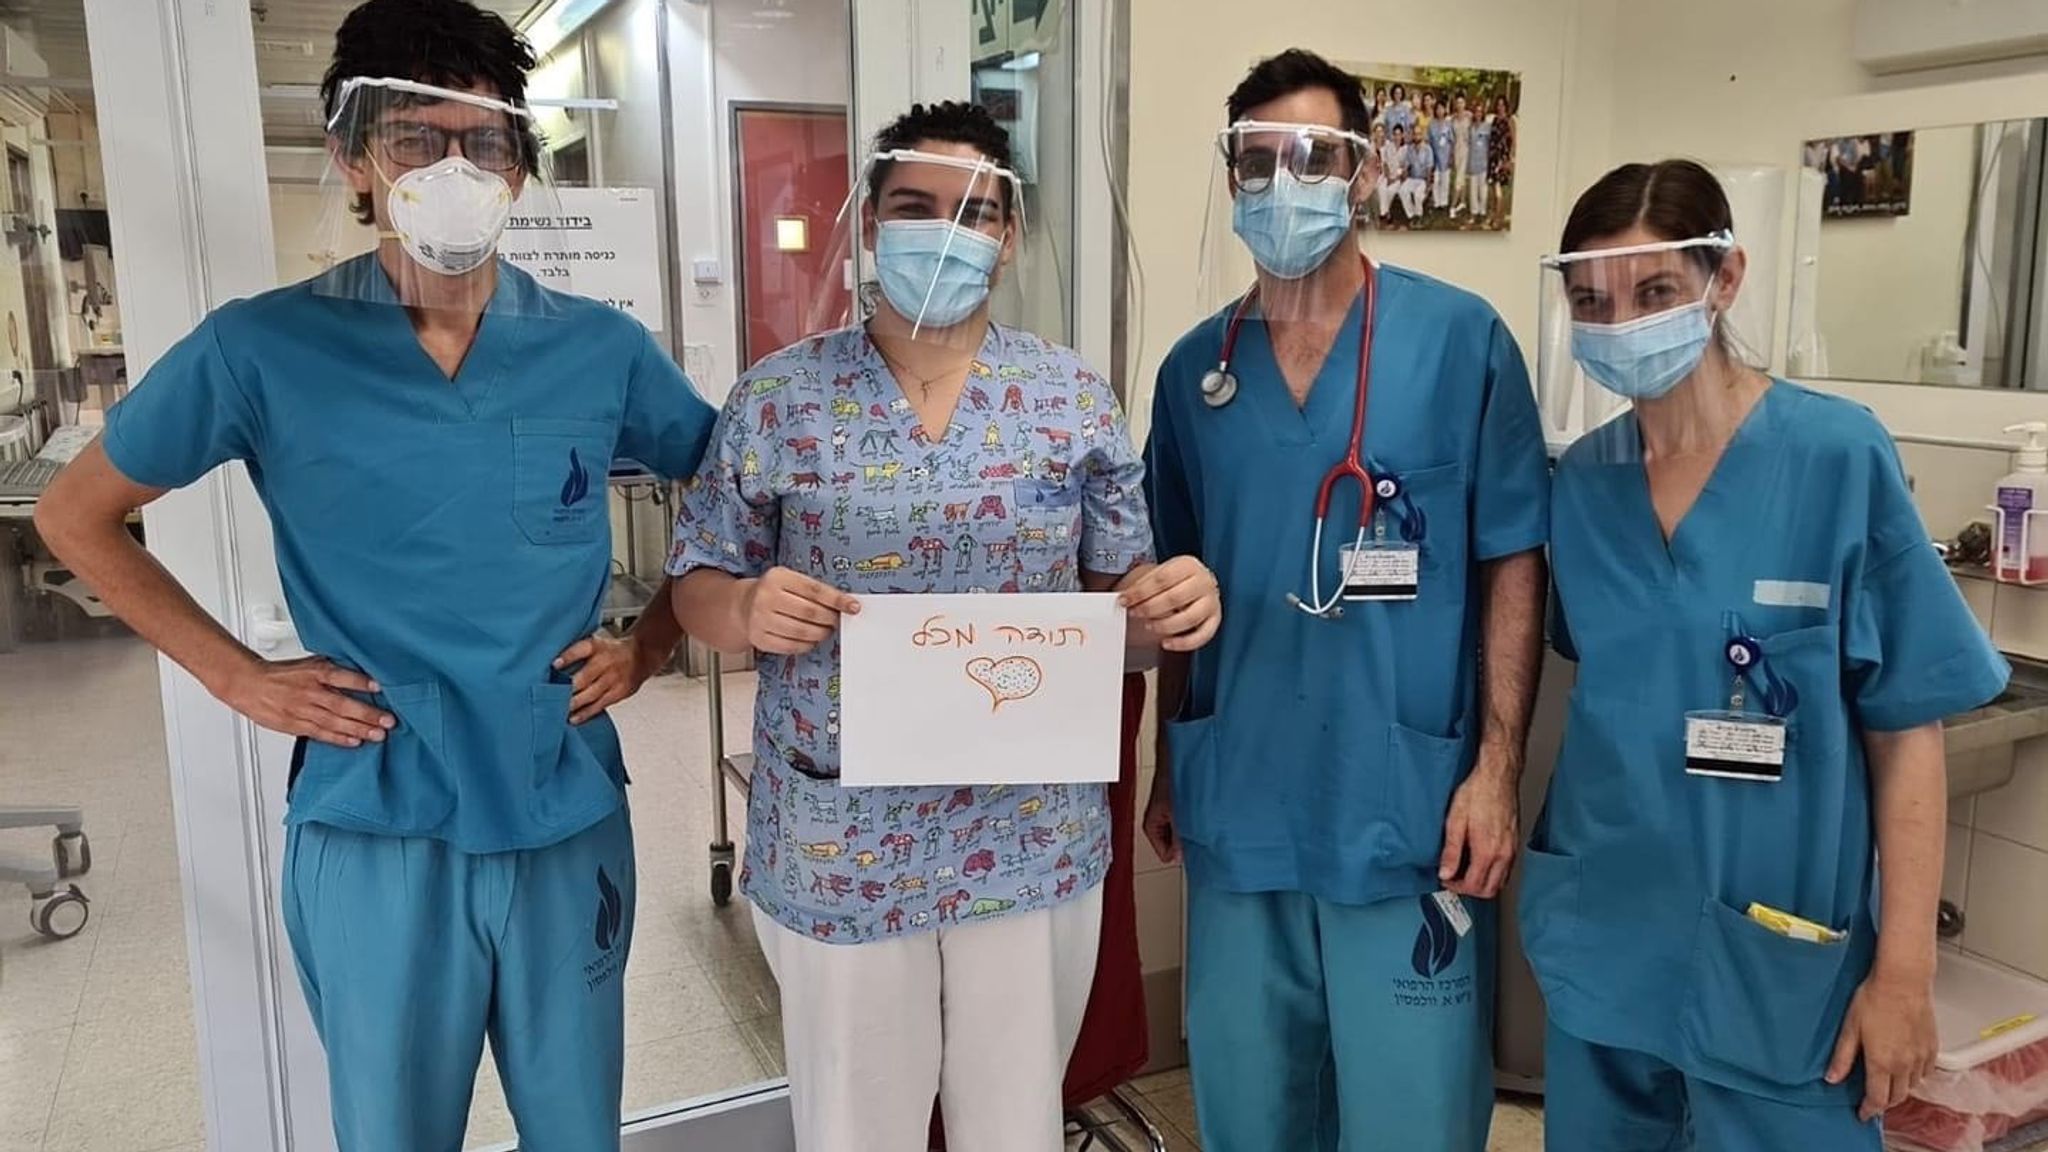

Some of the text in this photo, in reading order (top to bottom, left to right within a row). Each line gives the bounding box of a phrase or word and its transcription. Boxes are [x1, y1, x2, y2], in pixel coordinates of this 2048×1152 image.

[509, 216, 592, 226] בידוד נשימת
[510, 248, 539, 261] לצוות
[544, 251, 581, 261] מותרת
[585, 251, 616, 261] כניסה
[994, 626, 1083, 646] תודה
